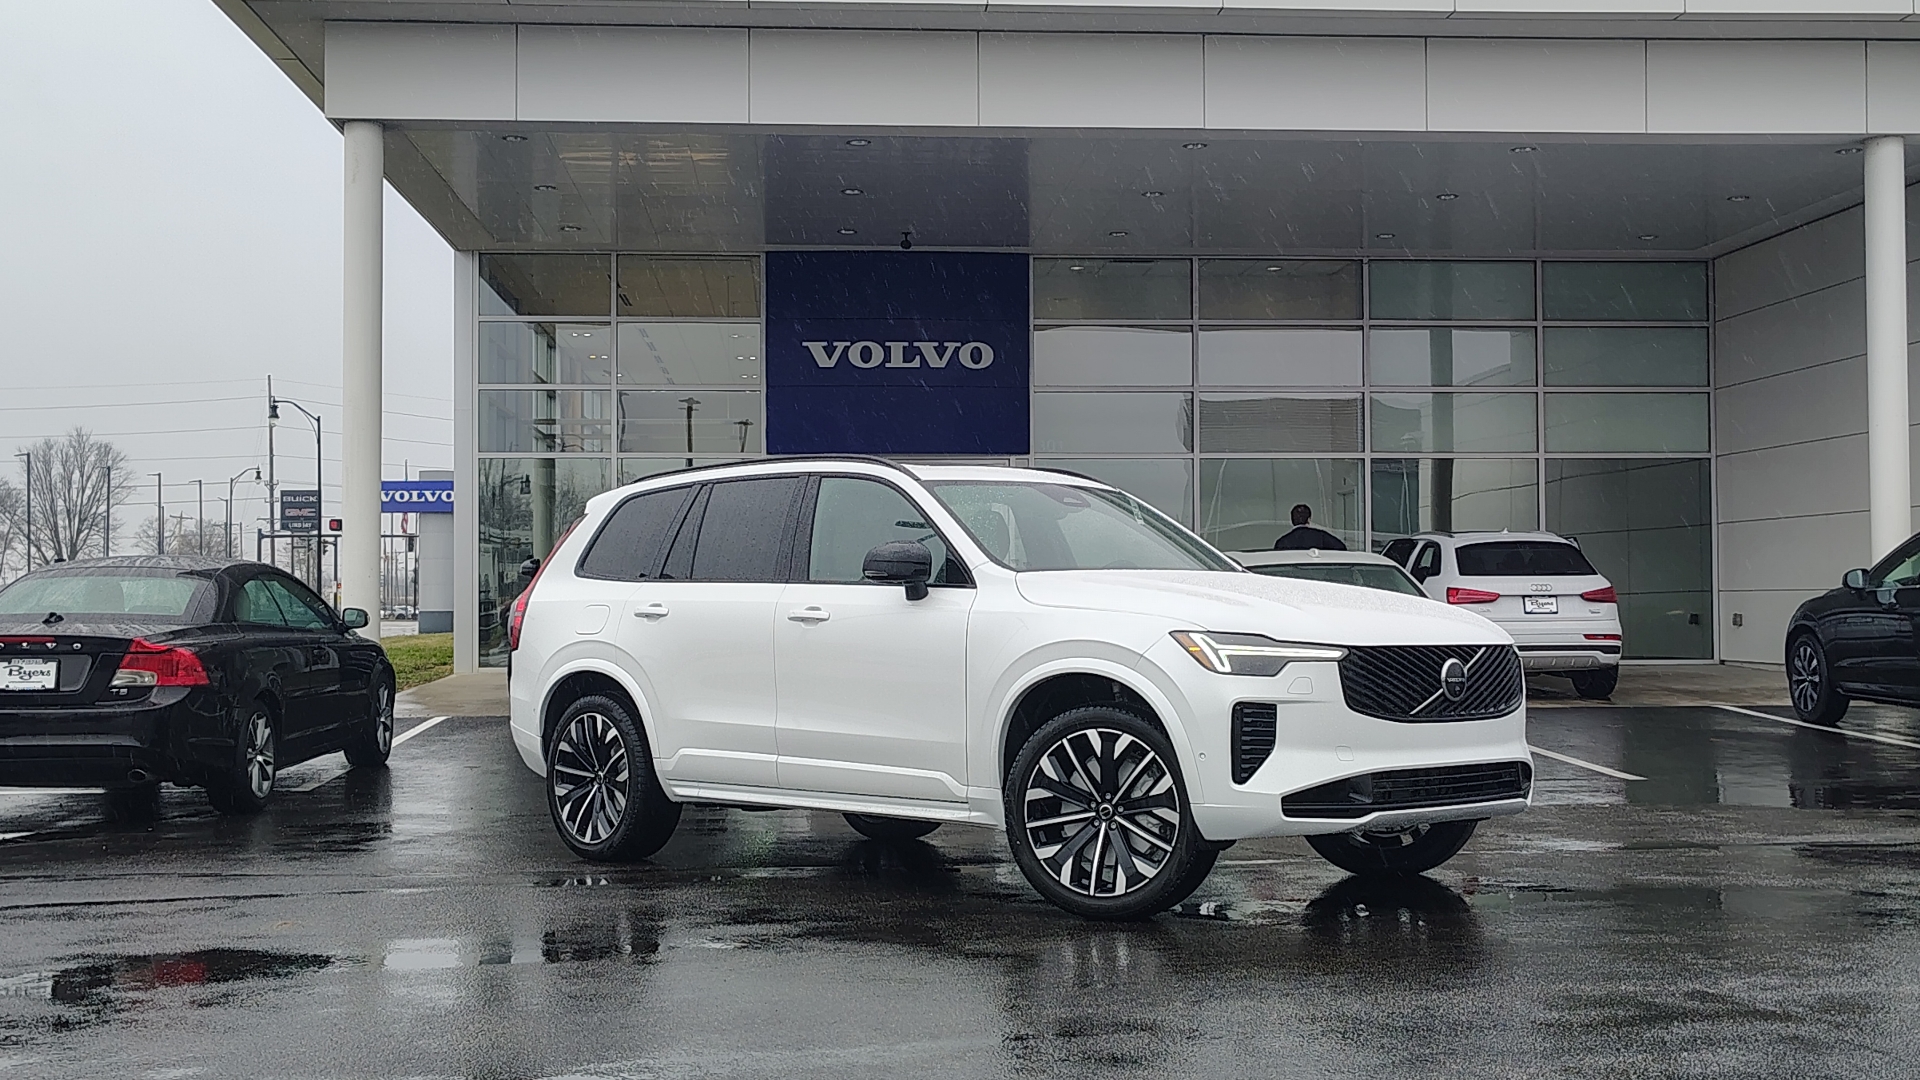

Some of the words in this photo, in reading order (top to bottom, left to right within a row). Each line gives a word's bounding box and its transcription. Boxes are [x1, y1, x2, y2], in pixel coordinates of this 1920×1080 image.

[802, 341, 994, 369] VOLVO
[381, 491, 455, 502] VOLVO
[285, 508, 316, 517] GMC
[2, 664, 51, 680] Byers
[109, 688, 128, 696] T5
